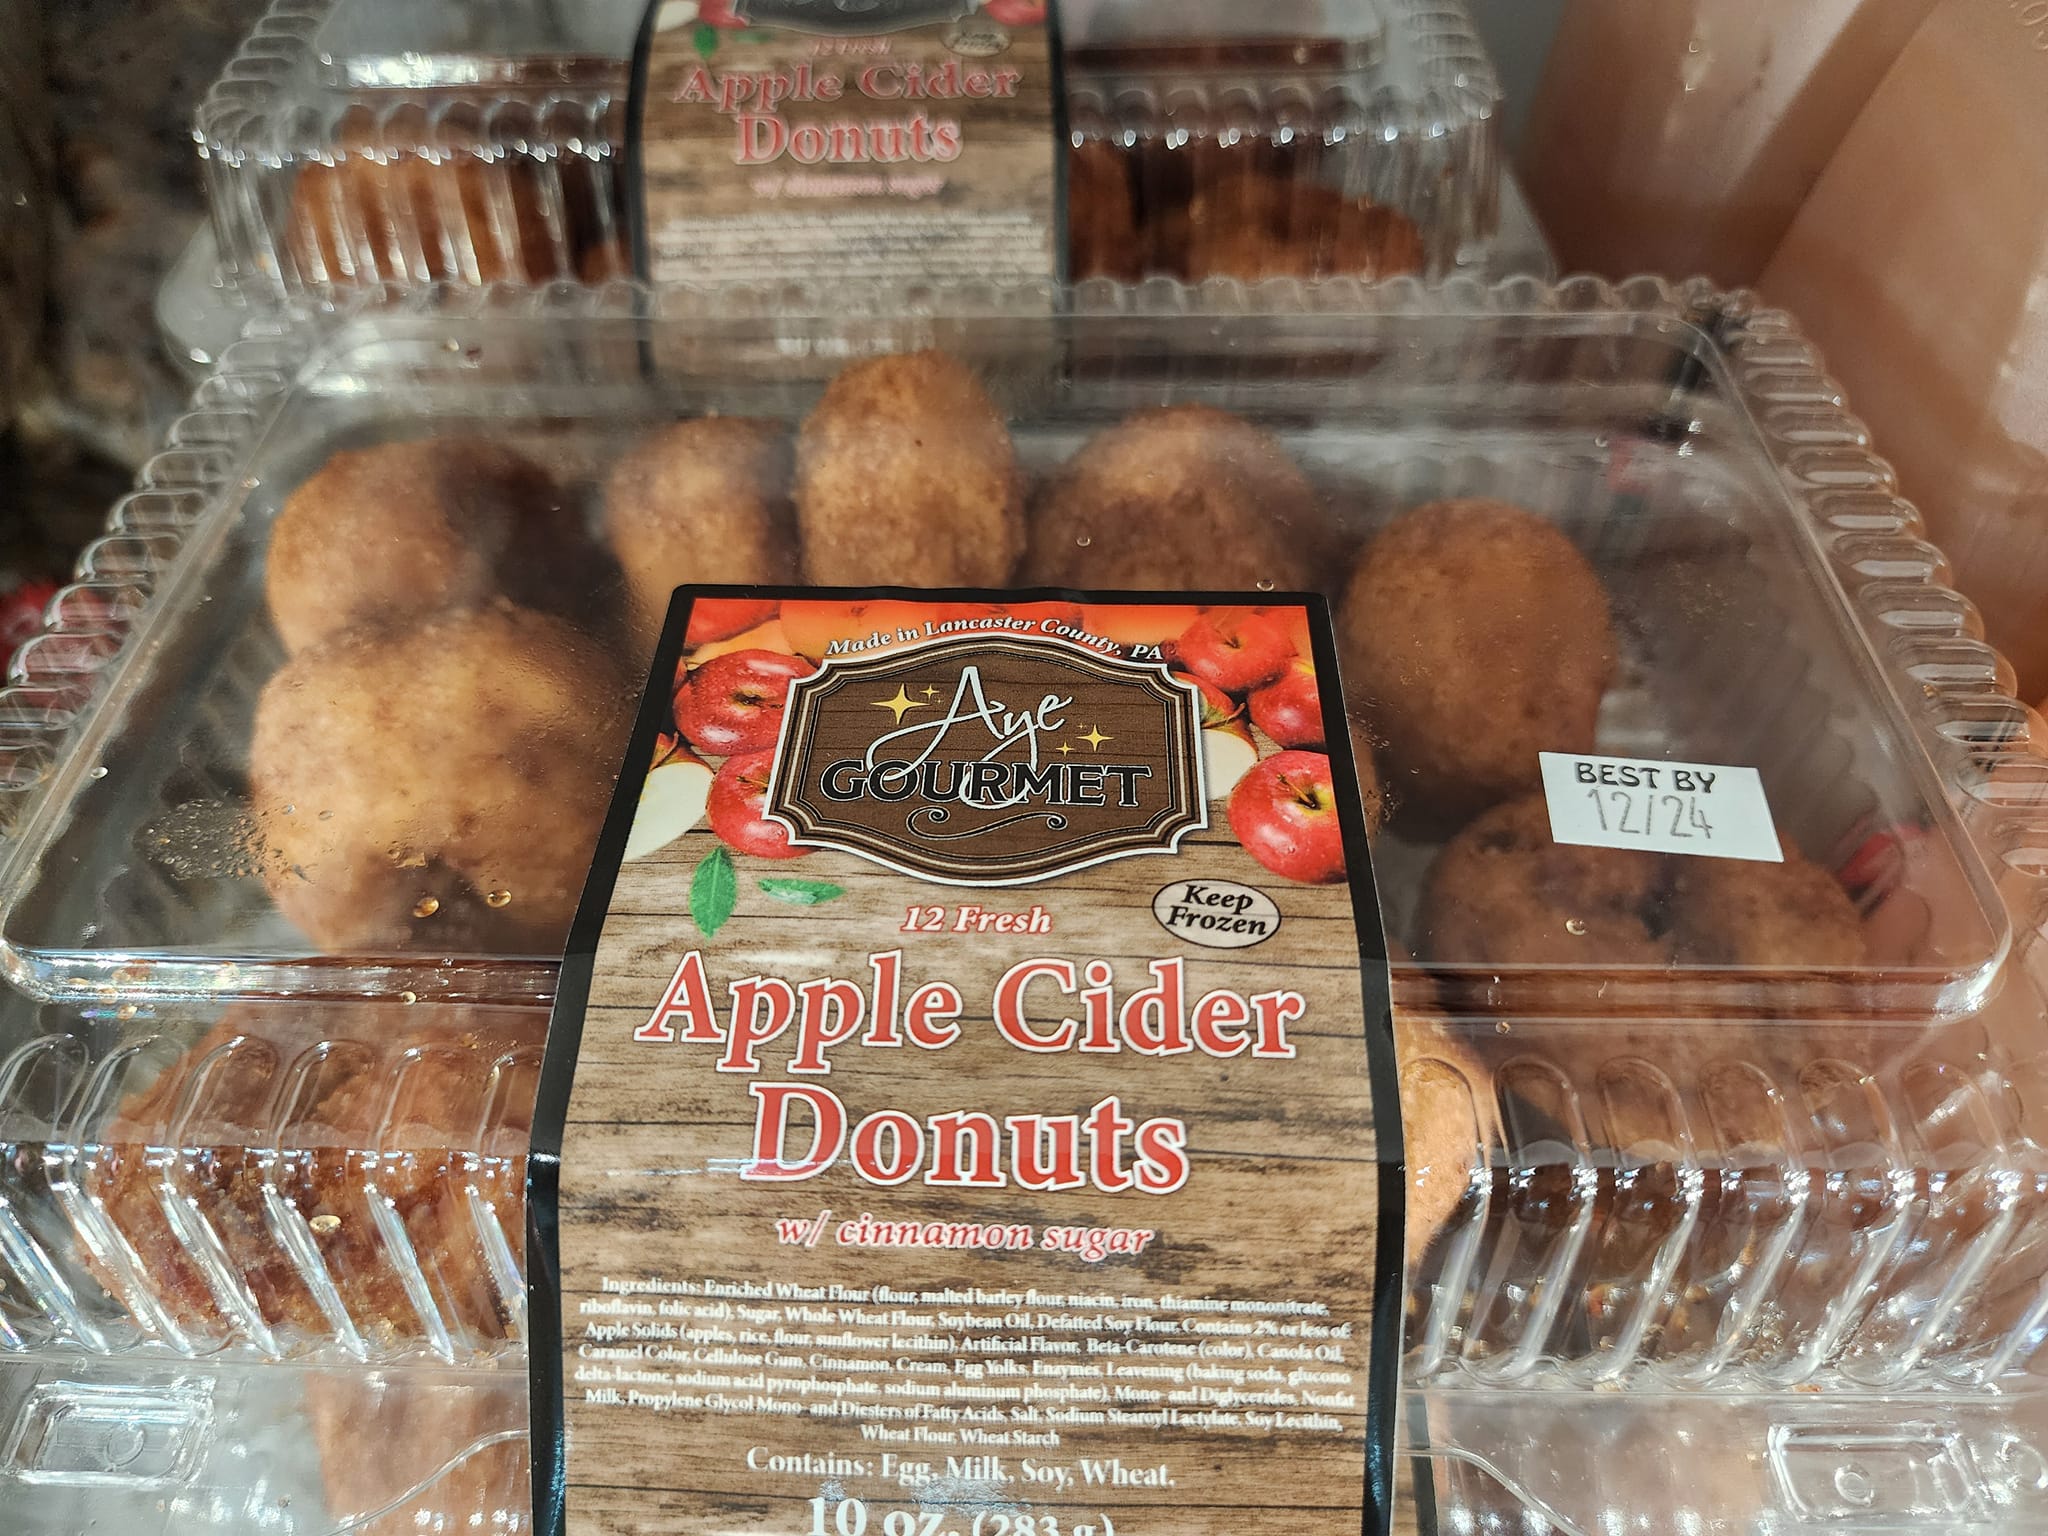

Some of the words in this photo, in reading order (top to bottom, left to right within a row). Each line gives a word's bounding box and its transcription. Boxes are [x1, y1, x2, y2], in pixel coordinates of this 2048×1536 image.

[673, 62, 845, 113] Apple
[857, 58, 1023, 98] Cider
[735, 111, 963, 164] Donuts
[826, 631, 891, 657] Made
[896, 626, 921, 645] in
[923, 615, 1036, 638] Lancaster
[1039, 617, 1122, 660] County,
[1130, 643, 1164, 661] PA
[866, 666, 1073, 810] Aye
[821, 759, 1152, 808] GOURMET
[1575, 762, 1660, 789] BEST
[1672, 770, 1716, 793] BY
[1587, 789, 1713, 839] 12/24
[1182, 884, 1253, 914] Keep
[901, 905, 945, 933] 12
[952, 905, 1052, 935] Fresh
[1165, 906, 1266, 937] Frozen
[634, 950, 962, 1073] Apple
[993, 956, 1304, 1058] Cider
[741, 1082, 1190, 1193] Donuts
[775, 1209, 832, 1247] w/
[837, 1213, 1031, 1250] cinnamon
[1041, 1226, 1155, 1265] sugar
[602, 1277, 700, 1299] Ingredients:
[705, 1280, 772, 1297] Enriched
[776, 1282, 825, 1299] Wheat
[829, 1284, 870, 1300] Flour
[659, 1301, 690, 1317] folic
[785, 1306, 836, 1322] Whole
[839, 1308, 888, 1324] Wheat
[938, 1312, 1002, 1332] Soybean
[1037, 1315, 1102, 1331] Defatted
[1105, 1317, 1134, 1336] Soy
[1253, 1320, 1278, 1336] 2%
[1280, 1325, 1299, 1336] or
[585, 1321, 630, 1342] Apple
[632, 1323, 678, 1340] Solids
[816, 1330, 889, 1348] sunflower
[962, 1335, 1027, 1352] Artificial
[1257, 1343, 1312, 1360] Canola
[578, 1343, 643, 1361] Caramel
[694, 1348, 762, 1366] Cellulose
[955, 1358, 984, 1379] Egg
[676, 1370, 731, 1388] sodium
[733, 1373, 764, 1389] acid
[884, 1379, 940, 1396] sodium
[944, 1381, 1020, 1398] aluminum
[1168, 1387, 1198, 1403] and
[1302, 1390, 1355, 1407] Nonfat
[628, 1390, 702, 1414] Propylene
[705, 1394, 753, 1416] Glycol
[809, 1399, 838, 1415] and
[841, 1401, 902, 1418] Diesters
[1046, 1407, 1104, 1424] Sodium
[1245, 1411, 1272, 1432] Soy
[861, 1424, 910, 1442] Wheat
[960, 1428, 1009, 1445] Wheat
[1012, 1430, 1060, 1447] Starch
[747, 1446, 872, 1476] Contains:
[881, 1453, 938, 1487] Egg,
[946, 1456, 1014, 1485] Milk,
[1021, 1458, 1074, 1493] Soy,
[1080, 1459, 1175, 1487] Wheat.
[807, 1497, 867, 1536] 10
